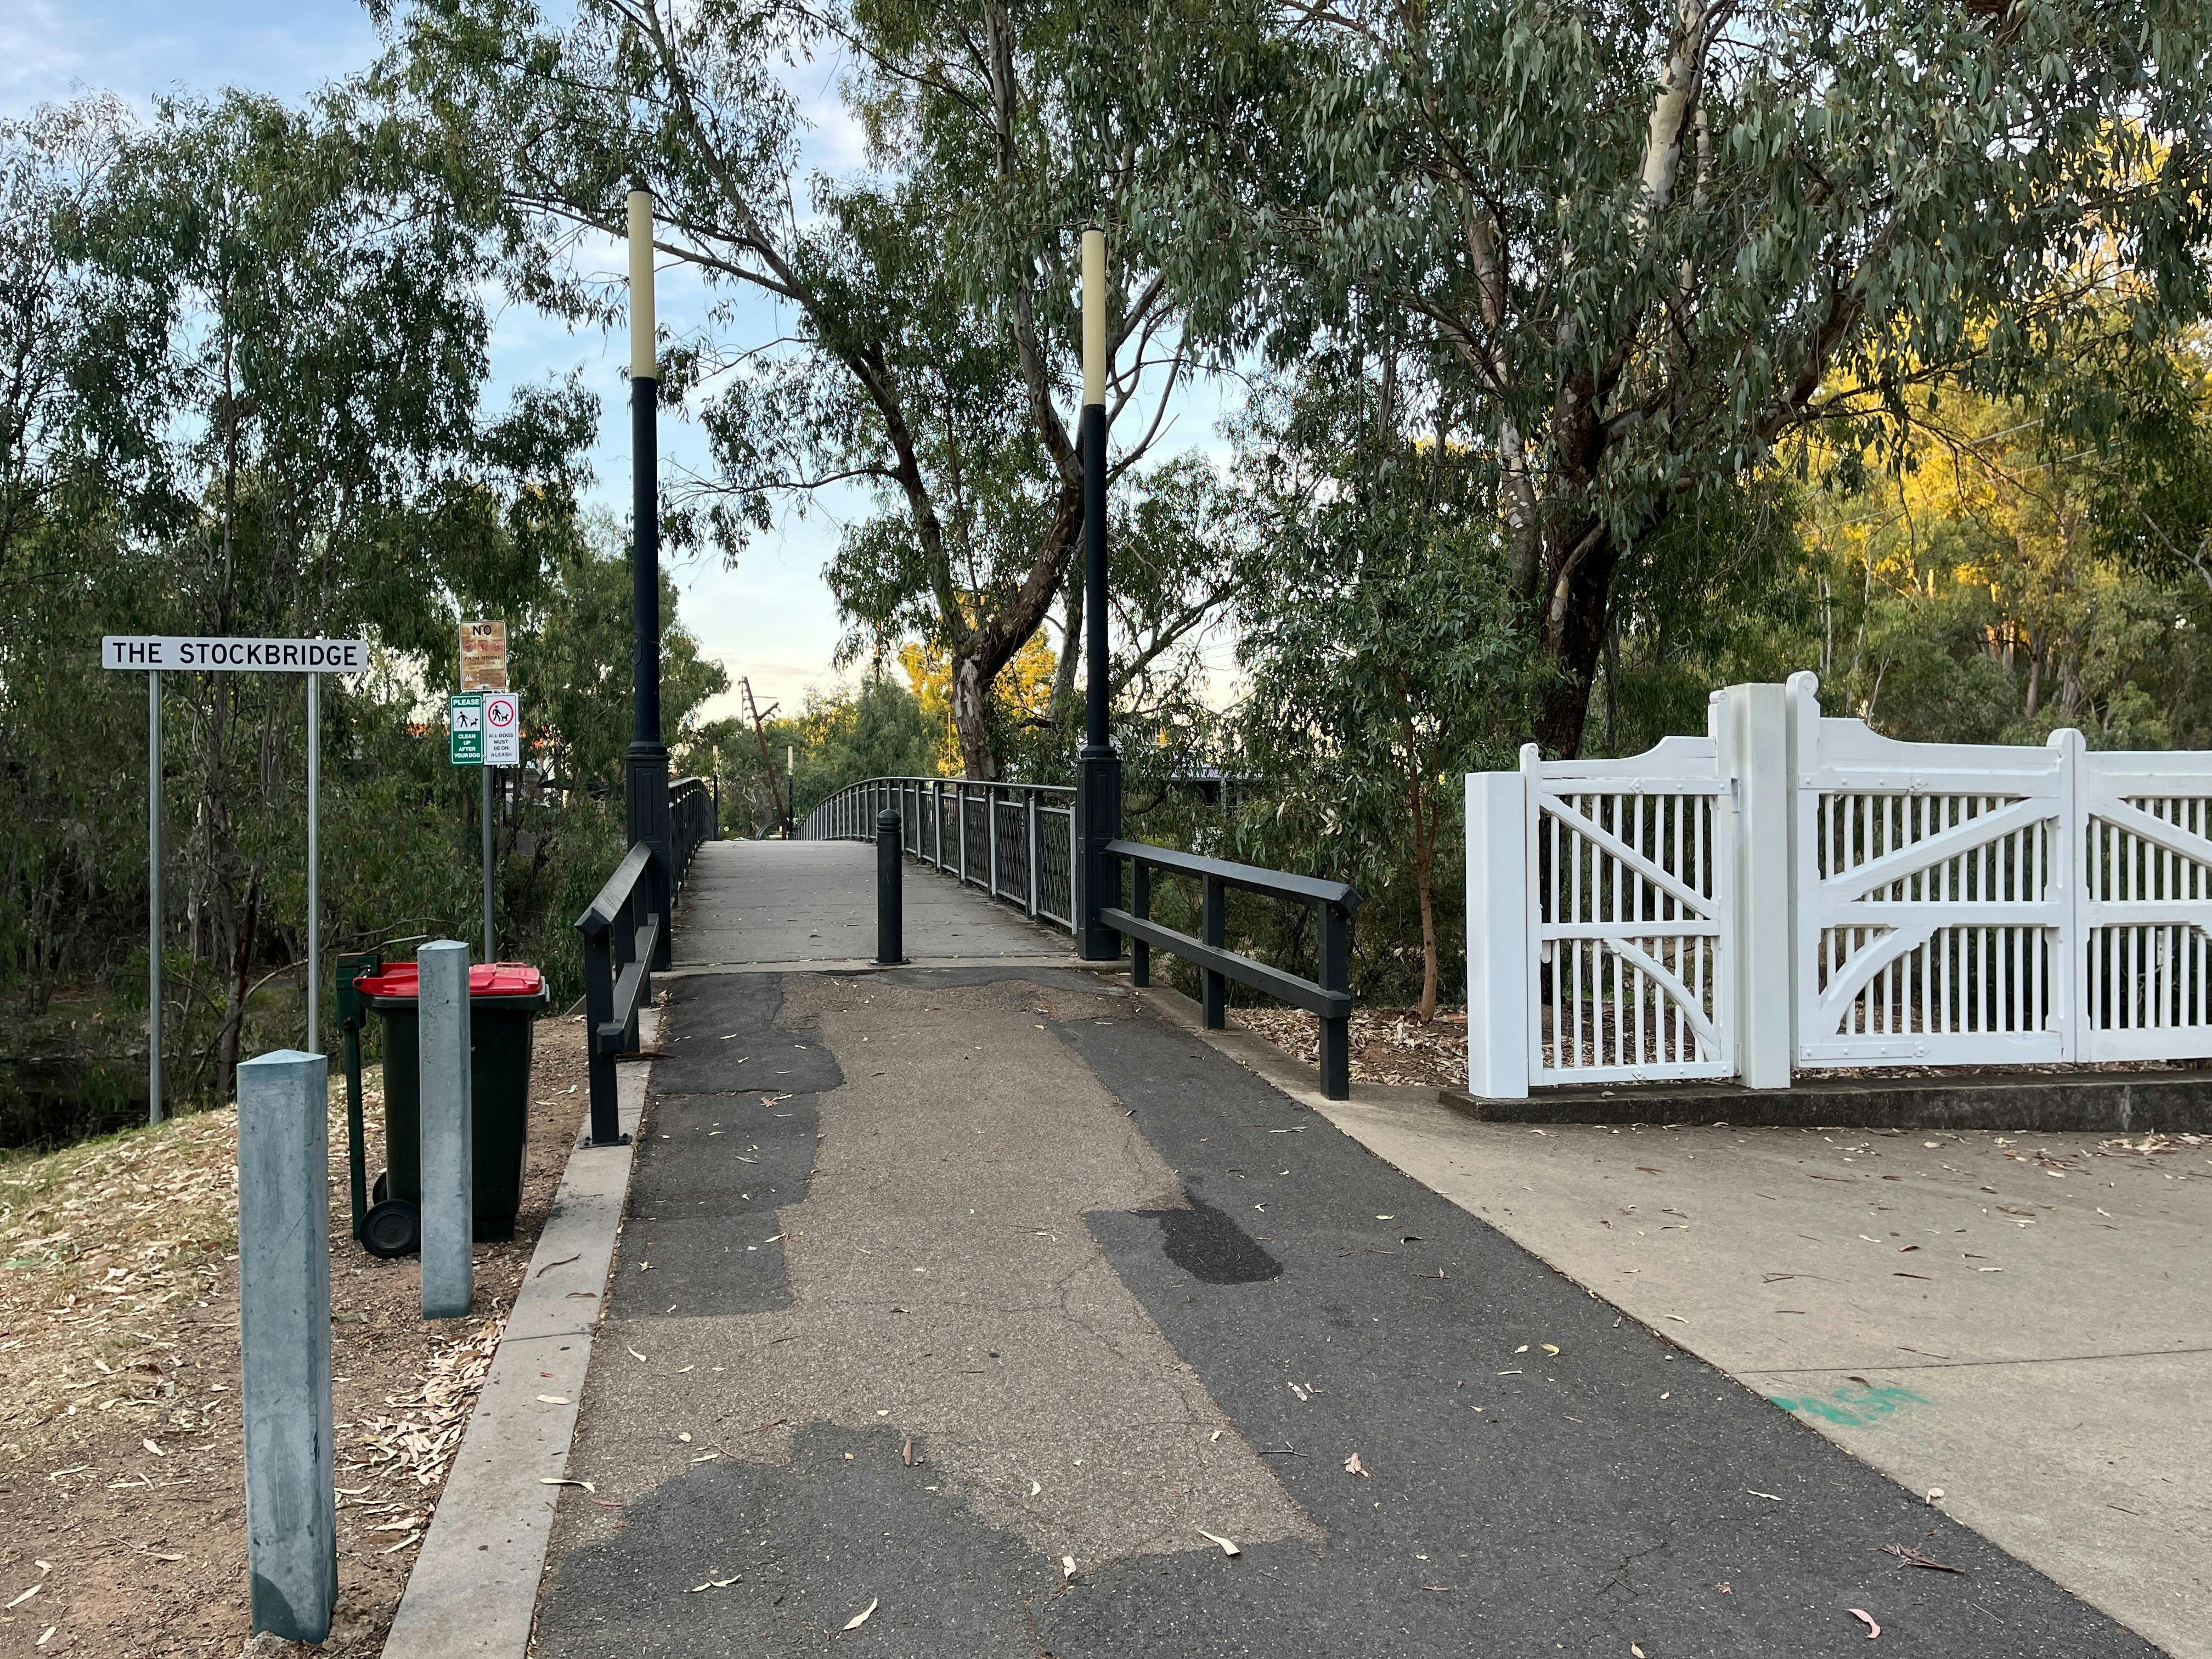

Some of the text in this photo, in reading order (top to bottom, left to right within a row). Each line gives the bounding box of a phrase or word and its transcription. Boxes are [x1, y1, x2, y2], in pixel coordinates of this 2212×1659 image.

[473, 625, 492, 635] NO
[112, 642, 358, 666] THE STOCKBRIDGE
